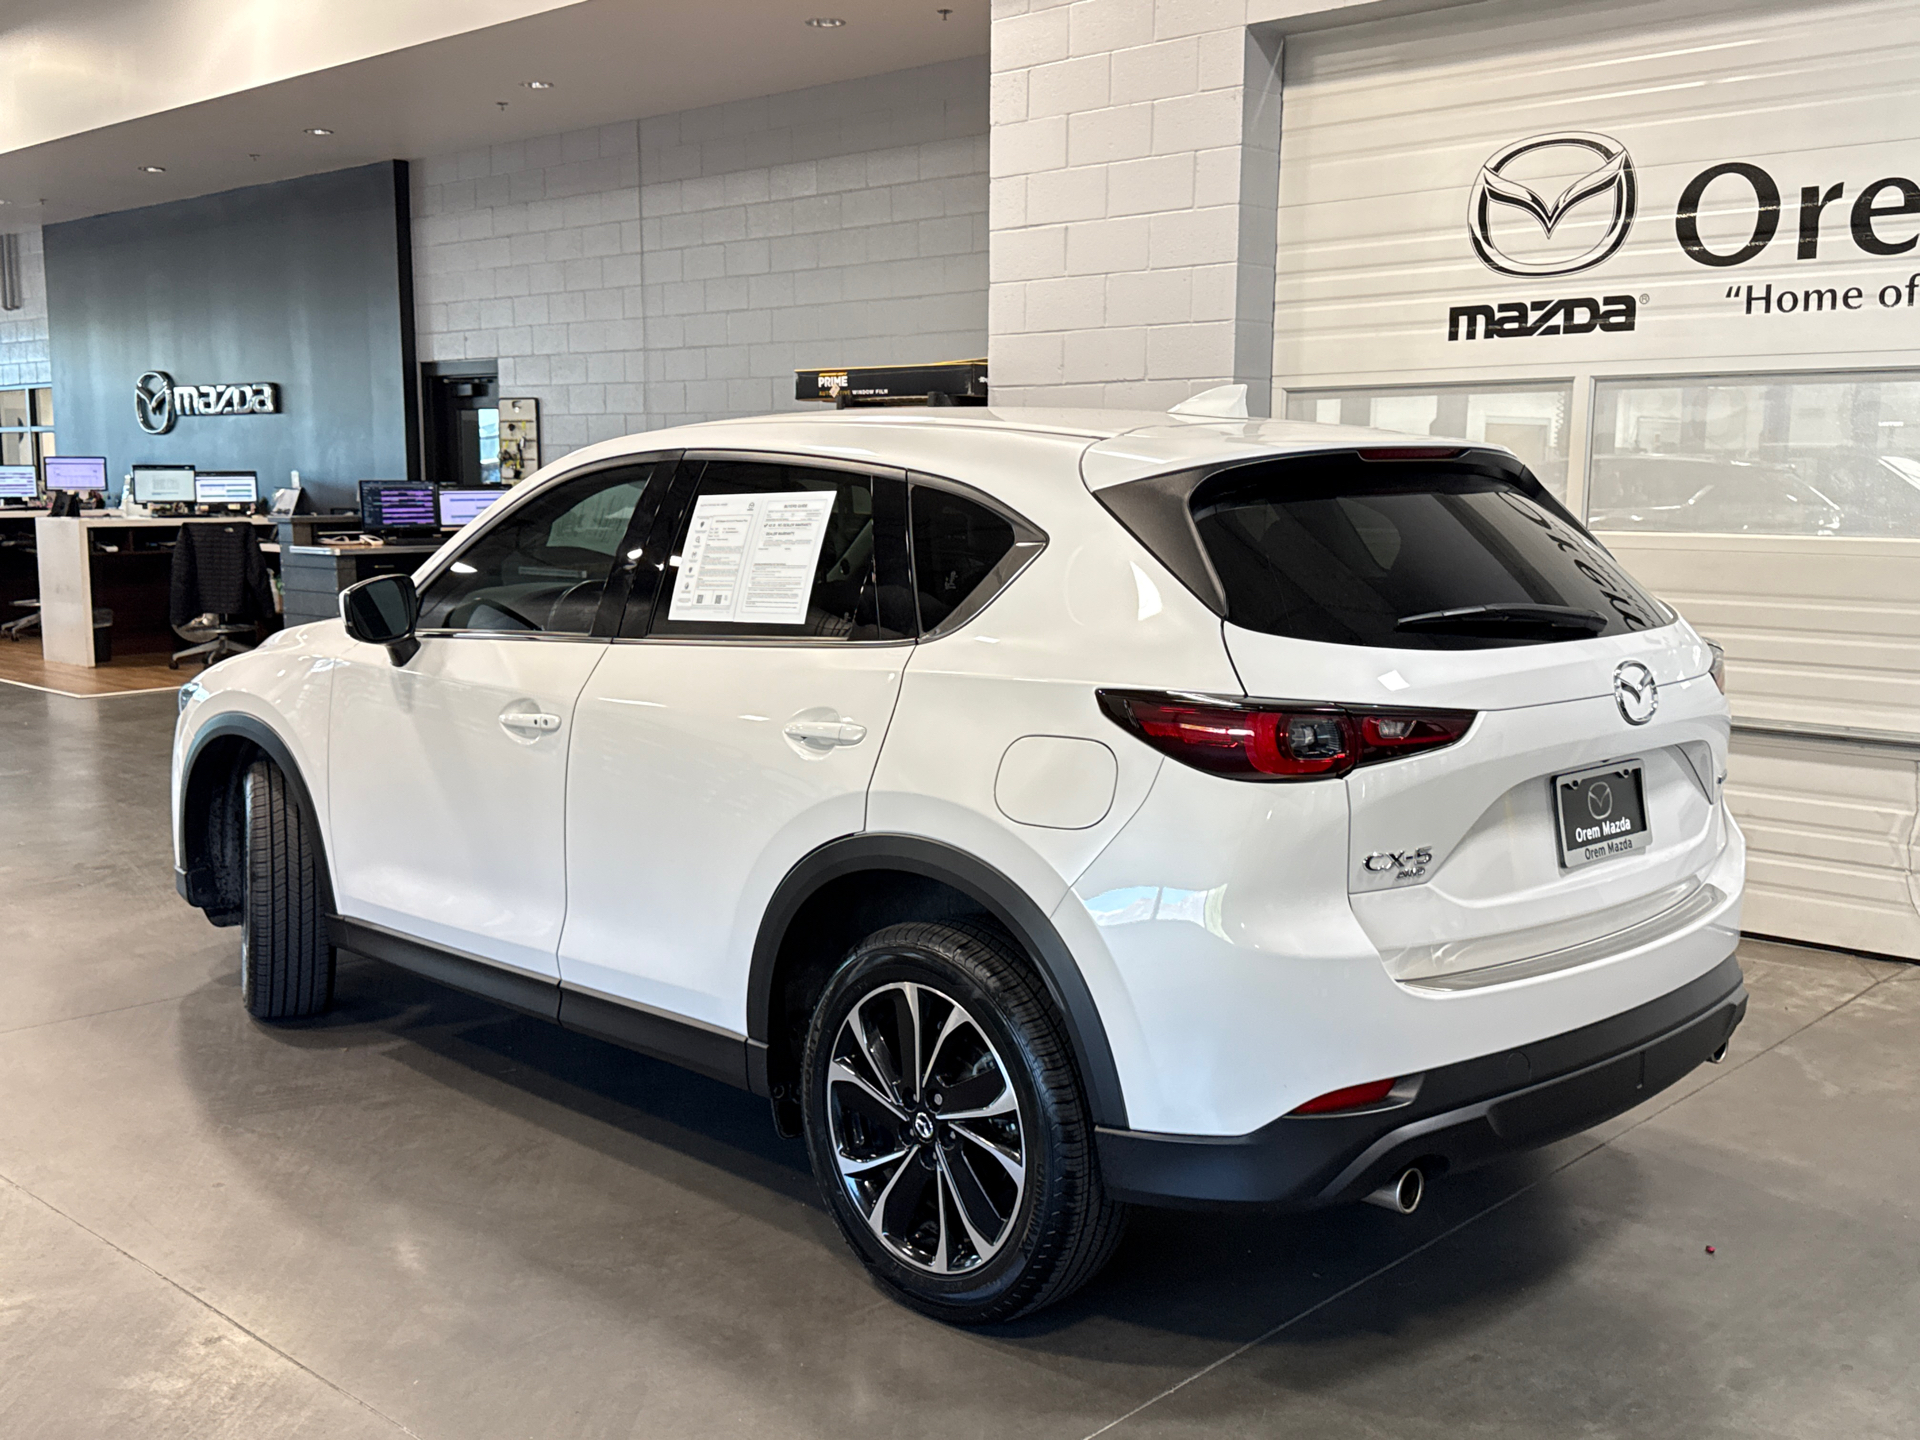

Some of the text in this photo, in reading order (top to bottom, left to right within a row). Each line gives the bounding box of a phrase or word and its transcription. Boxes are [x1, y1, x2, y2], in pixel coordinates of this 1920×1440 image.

[1675, 162, 1920, 267] Ore
[1878, 272, 1920, 309] of
[1448, 294, 1637, 342] mazda
[818, 376, 848, 388] PRIME
[818, 389, 851, 397] AUTTIVE
[174, 382, 280, 417] mazda
[1575, 816, 1632, 843] Orem Mazda
[1362, 846, 1432, 872] CX-5
[1585, 838, 1633, 860] Orem Mazda
[1395, 867, 1425, 881] AWD
